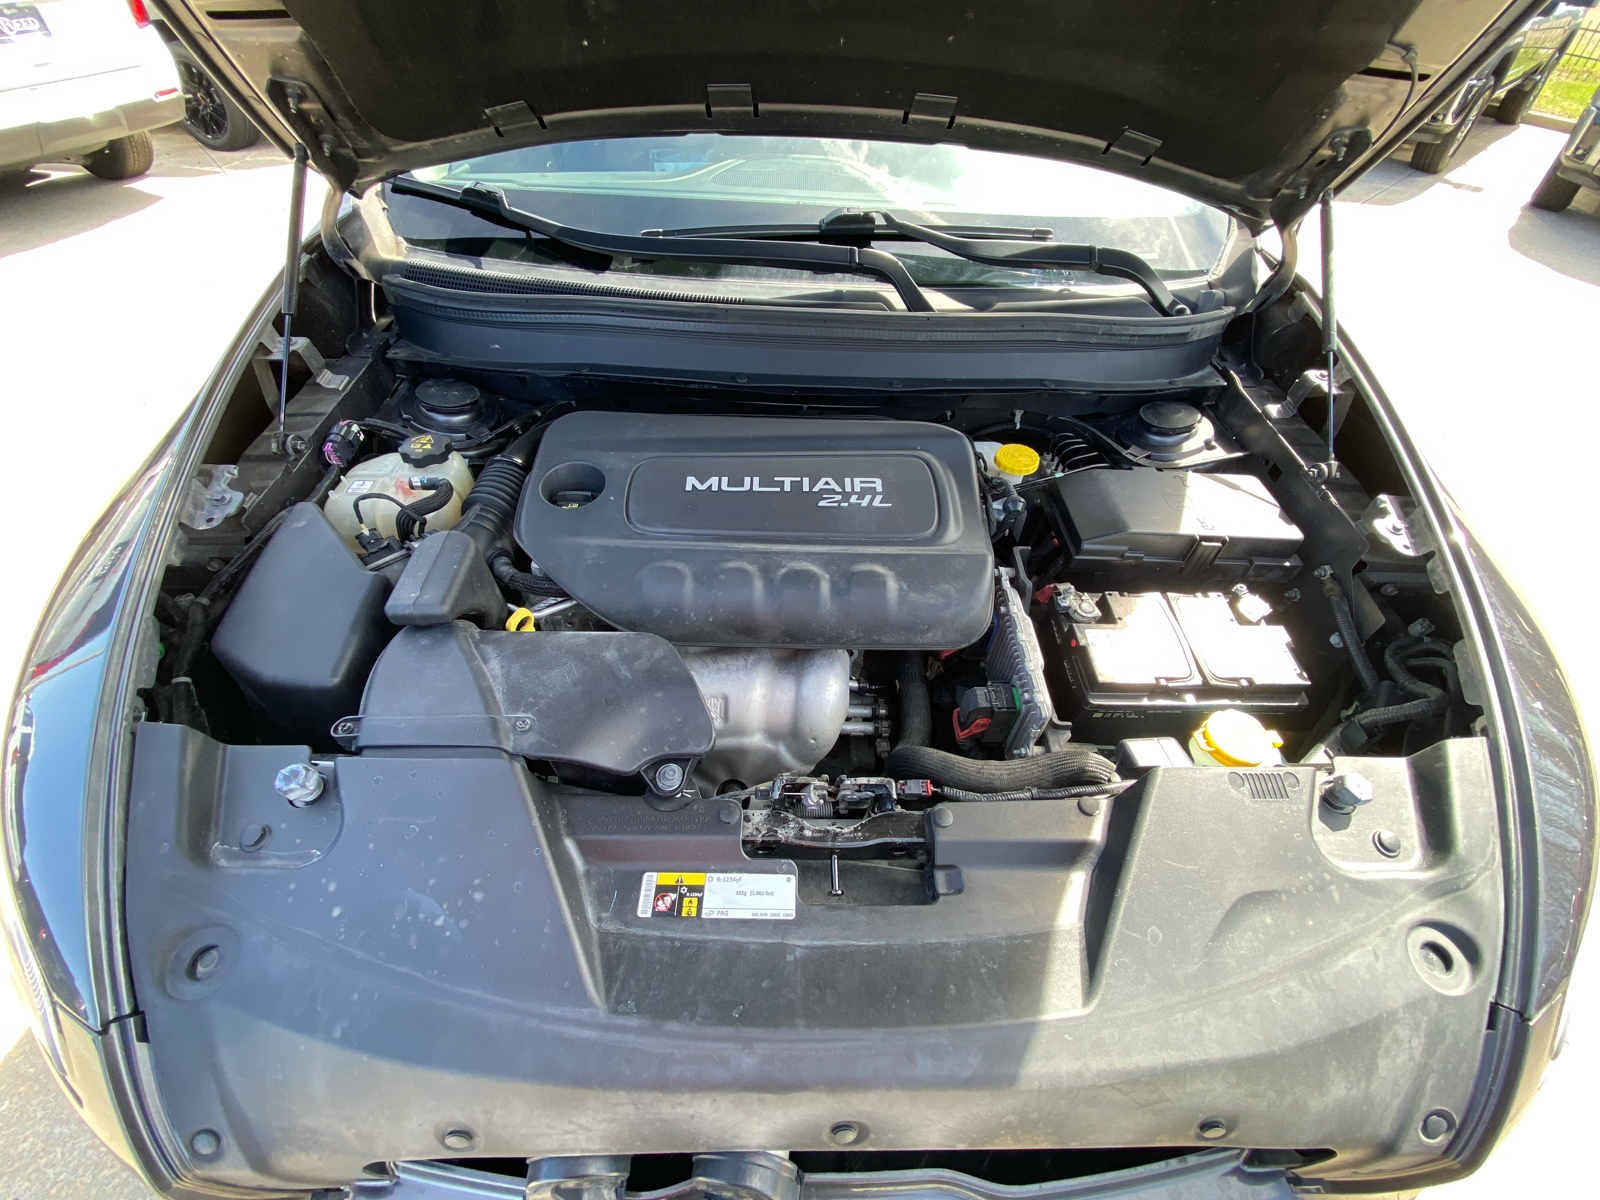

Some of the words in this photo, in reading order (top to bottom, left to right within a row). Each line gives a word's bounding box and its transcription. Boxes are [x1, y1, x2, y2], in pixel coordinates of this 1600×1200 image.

[685, 476, 883, 492] MULTIAIR
[817, 494, 893, 507] 2.4L
[716, 876, 742, 884] R-1234yf
